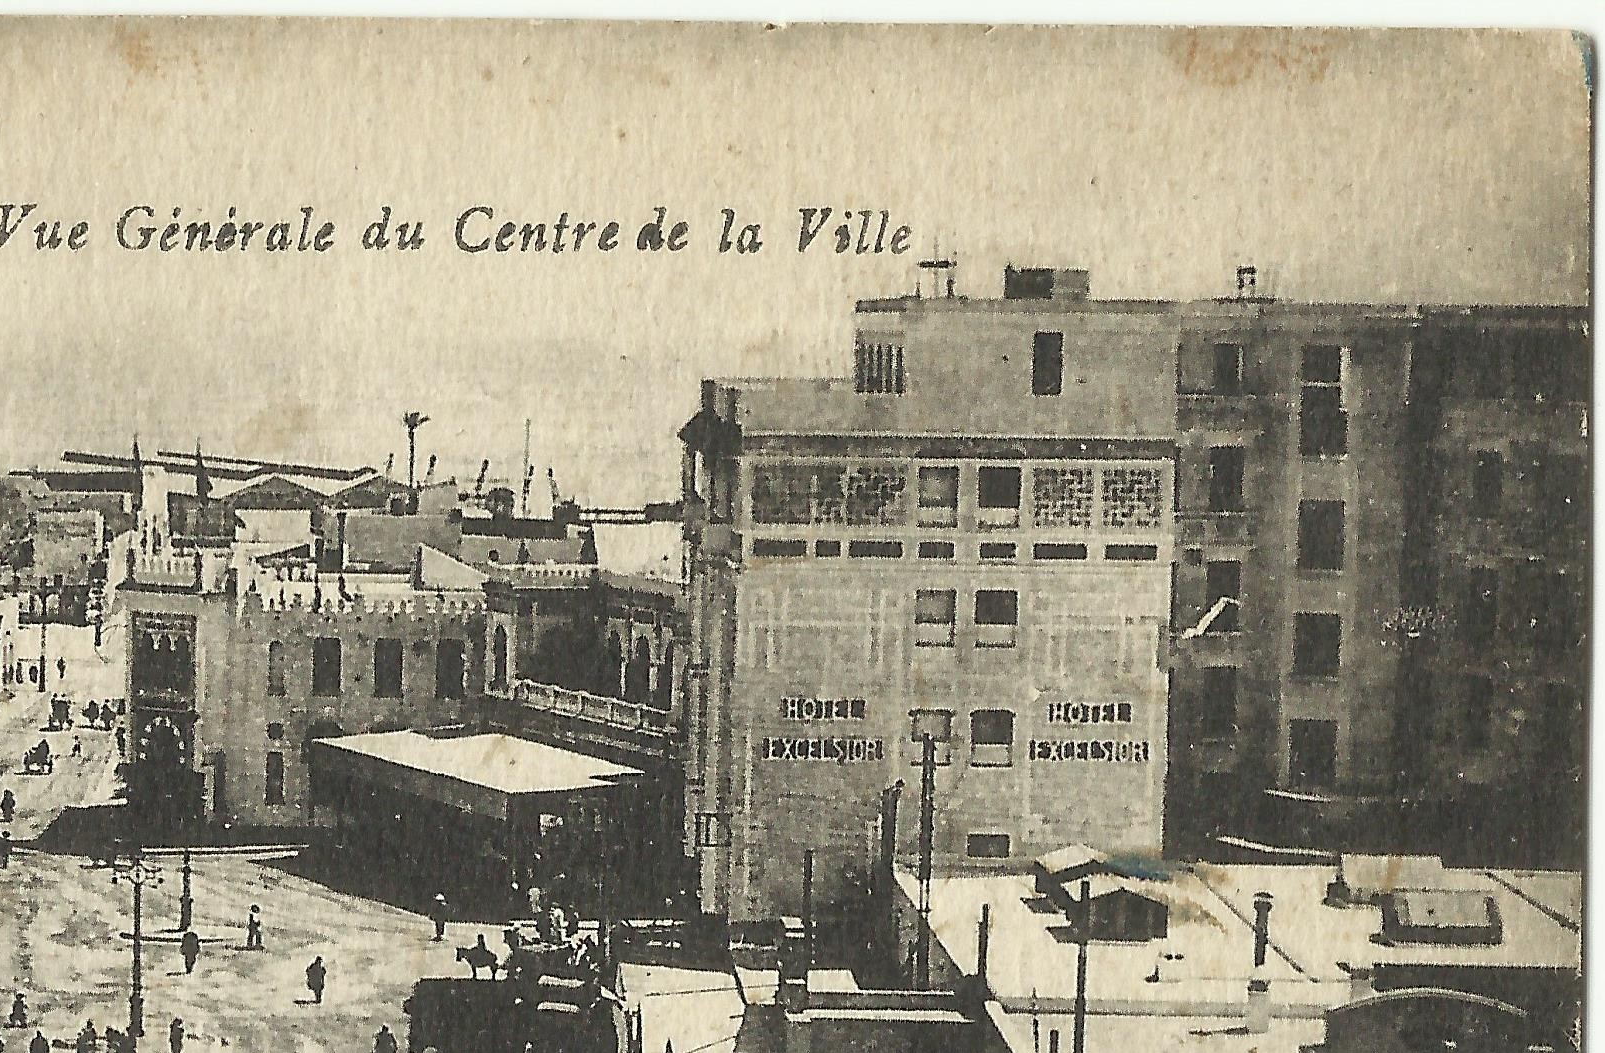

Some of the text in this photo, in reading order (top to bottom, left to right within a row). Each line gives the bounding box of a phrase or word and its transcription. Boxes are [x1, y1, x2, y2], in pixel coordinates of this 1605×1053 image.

[781, 697, 867, 720] HOTEL
[1048, 702, 1133, 724] HOTEL
[761, 737, 885, 761] EXCELSIOR
[1028, 740, 1150, 762] EXCELSIOR
